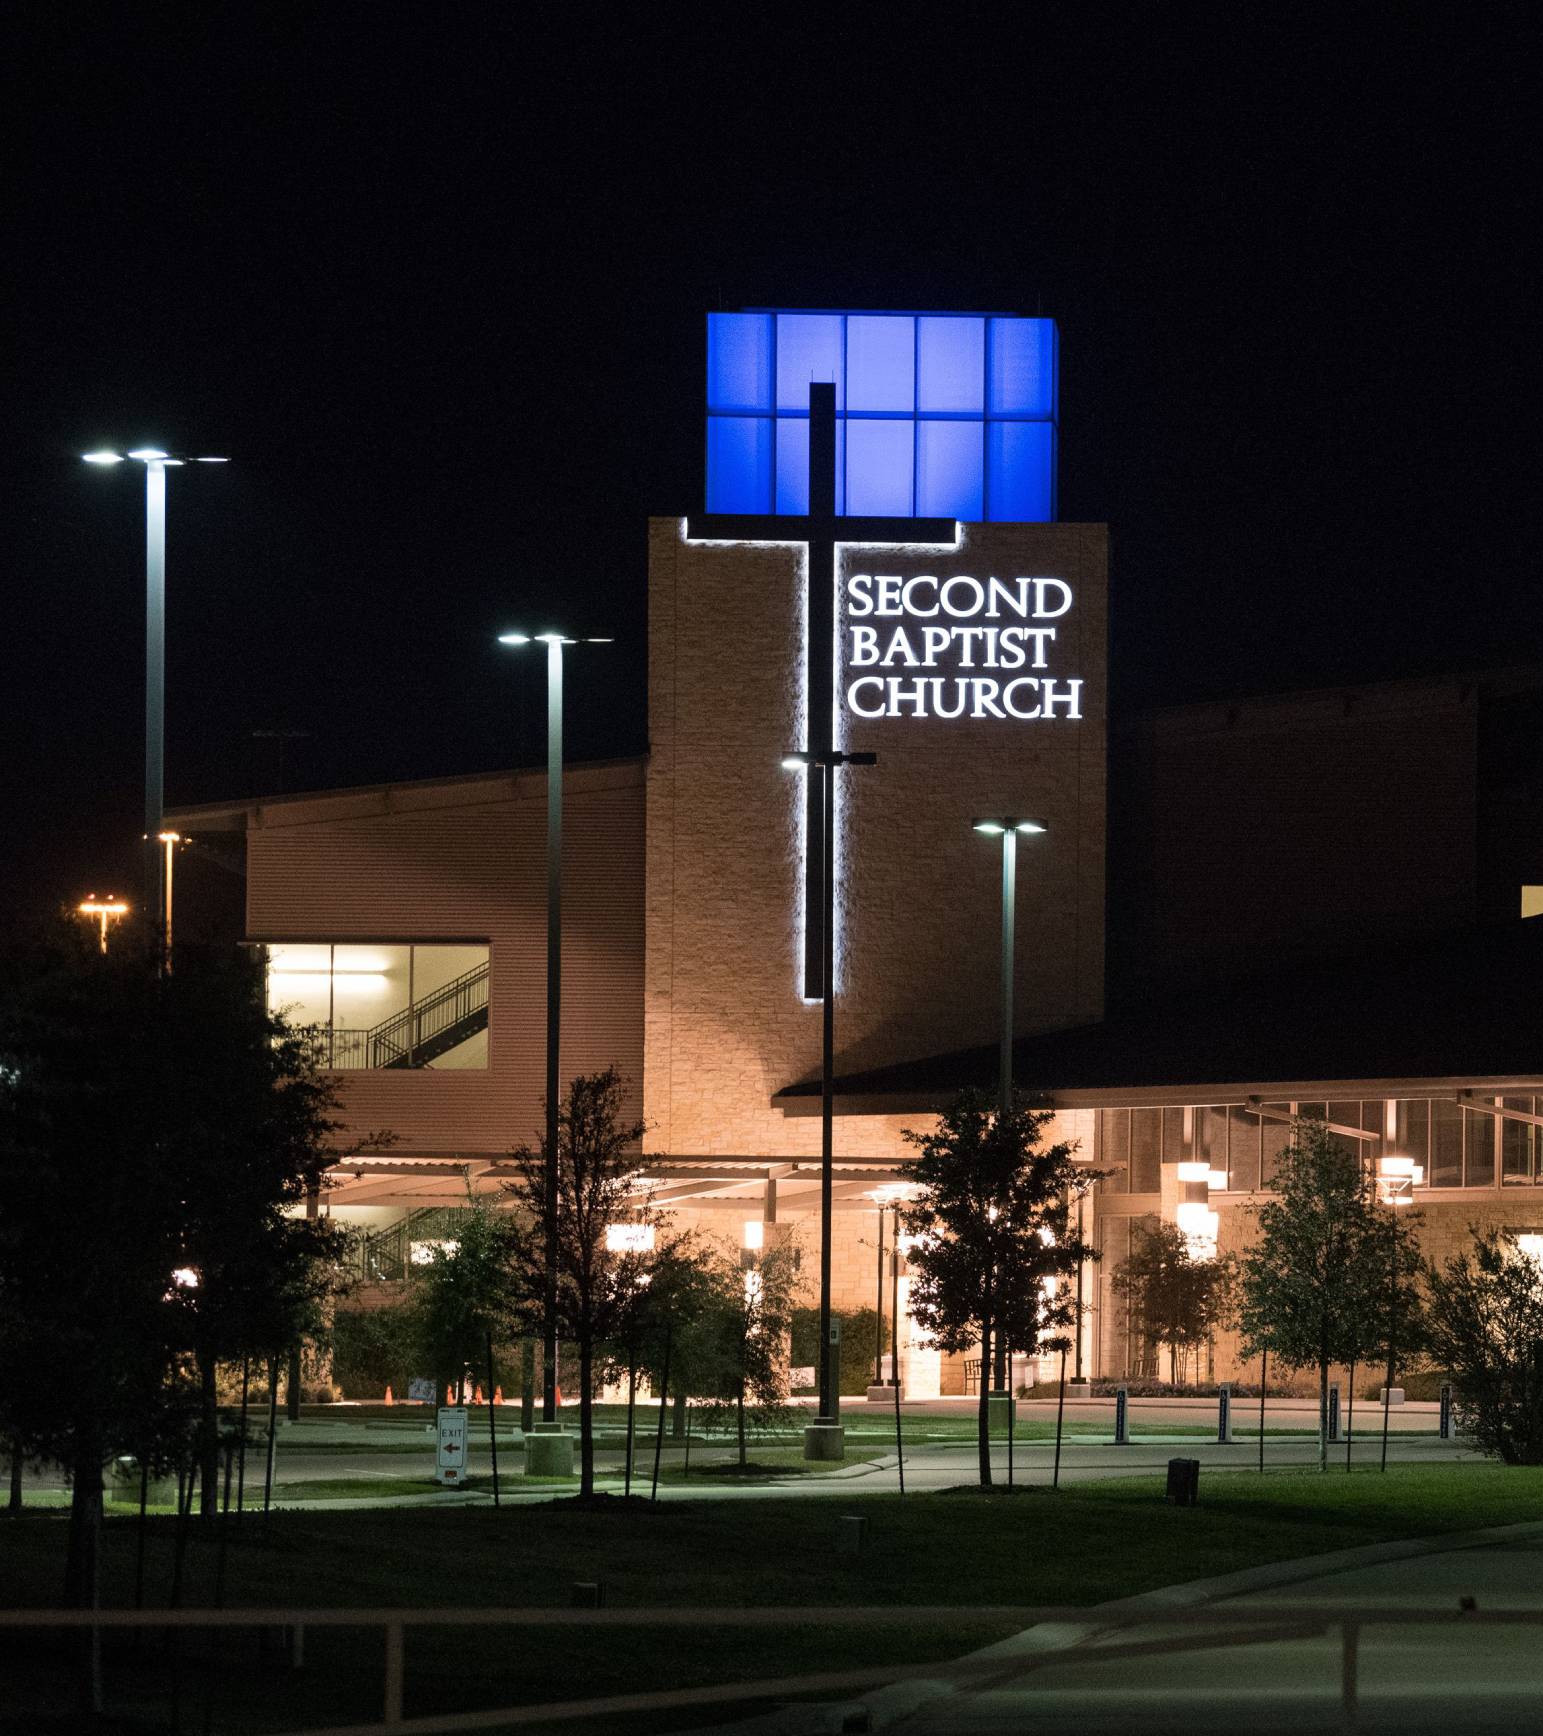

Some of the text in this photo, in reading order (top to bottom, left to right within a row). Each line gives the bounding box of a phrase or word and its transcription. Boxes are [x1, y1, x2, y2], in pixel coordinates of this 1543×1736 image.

[848, 575, 1072, 617] SECOND
[850, 626, 1055, 668] BAPTIST
[847, 677, 1083, 718] CHURCH
[442, 1429, 462, 1438] EXIT
